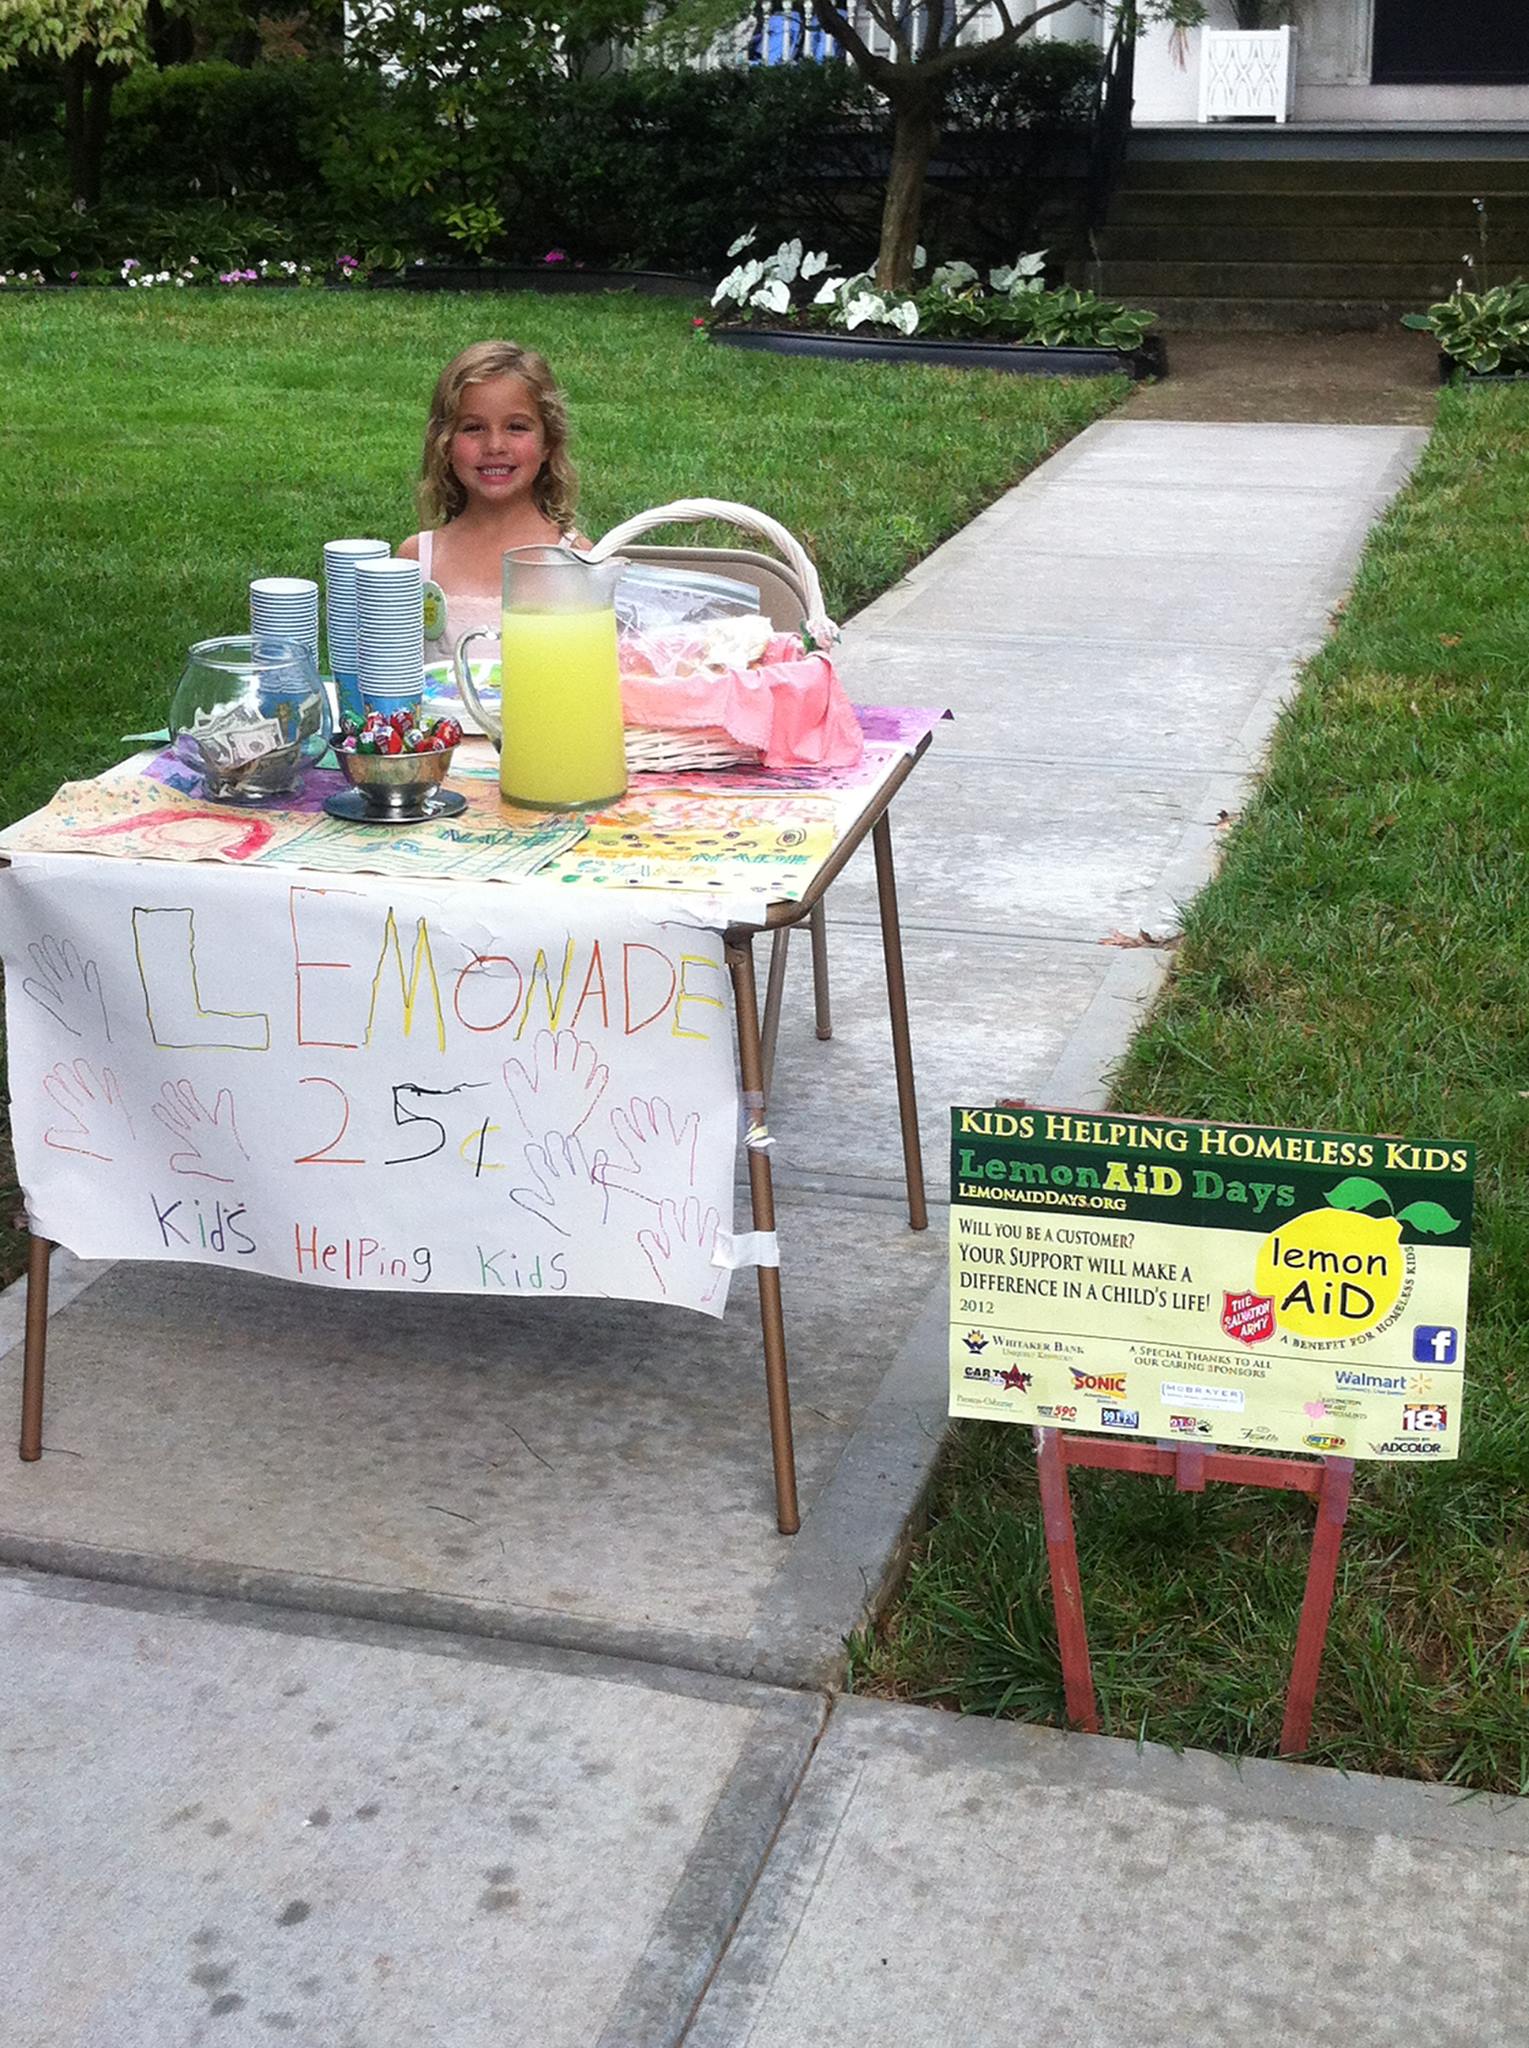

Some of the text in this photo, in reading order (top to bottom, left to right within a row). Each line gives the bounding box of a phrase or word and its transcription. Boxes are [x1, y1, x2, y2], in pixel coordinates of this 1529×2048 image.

[961, 1110, 1468, 1172] KIDS HELPING HOMELESS KIDS
[958, 1149, 1295, 1213] LemonAiD Days
[959, 1218, 1135, 1249] WILL YOU BE A CUSTOMER?
[959, 1243, 1193, 1283] YOUR SUPPORT WILL MAKE A
[1273, 1237, 1387, 1277] lemon
[960, 1272, 1211, 1313] DIFFERENCE IN A CHILD'S LIFE!
[1231, 1295, 1252, 1312] THE
[1281, 1280, 1374, 1319] AiD
[1293, 1338, 1346, 1350] BENEFIT
[1349, 1331, 1376, 1347] FOR
[1376, 1279, 1415, 1334] HOMELESS
[1404, 1246, 1416, 1275] KIDS
[960, 1299, 994, 1314] 2012
[1134, 1357, 1266, 1379] OUR CARING SPONSORS
[1140, 1346, 1183, 1360] SPECIAL
[1186, 1351, 1231, 1365] THANKS
[1235, 1358, 1250, 1368] TO
[1251, 1359, 1272, 1369] ALL
[1074, 1374, 1126, 1391] SONIC
[1336, 1370, 1407, 1390] Walmart
[1403, 1410, 1441, 1431] 18
[1381, 1442, 1441, 1453] ADCOLOR
